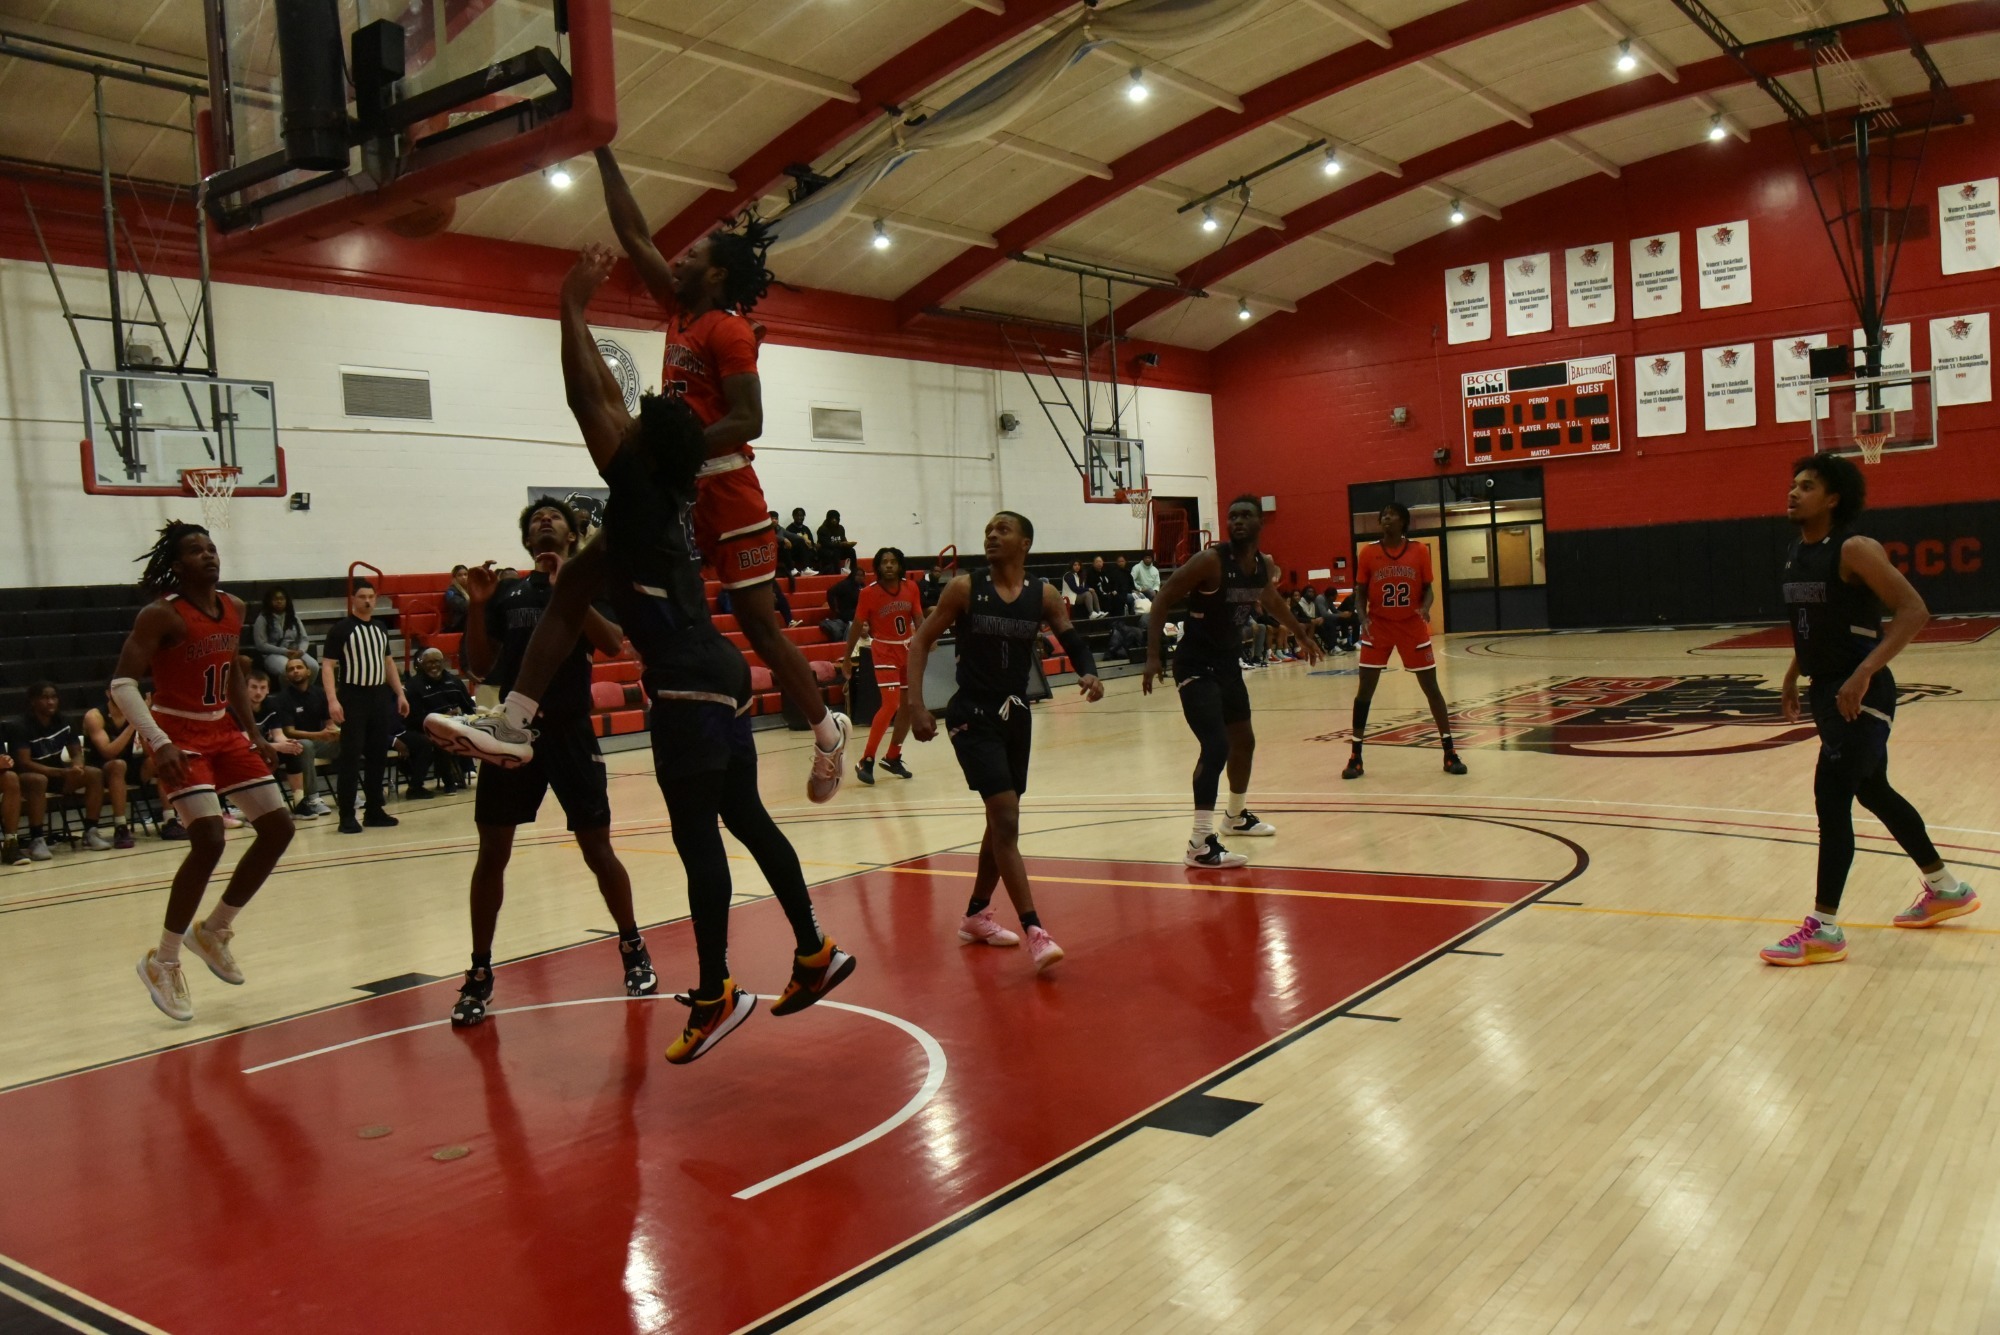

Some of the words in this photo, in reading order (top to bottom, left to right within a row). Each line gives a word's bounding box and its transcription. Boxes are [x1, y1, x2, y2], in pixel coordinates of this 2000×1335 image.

[1968, 201, 1991, 210] Basketball
[1959, 354, 1983, 362] Basketball
[619, 355, 634, 381] COLLEGE
[1957, 360, 1989, 369] Championship
[1570, 360, 1612, 381] BALTIMORE
[1467, 373, 1503, 386] BCCC
[1729, 379, 1749, 387] Basketball
[1576, 383, 1605, 395] GUEST
[1467, 395, 1511, 408] PANTHERS
[1528, 397, 1550, 405] PERIOD
[1566, 420, 1584, 429] T.O.L.
[1590, 417, 1610, 426] FOULS
[1519, 424, 1542, 433] PLAYER
[1546, 422, 1563, 430] FOUL
[1473, 430, 1491, 438] FOULS
[1591, 443, 1611, 451] SCORE
[1530, 449, 1550, 457] MATCH
[1474, 454, 1493, 463] SCORE
[1882, 536, 1984, 577] CCC
[1381, 582, 1411, 608] 22
[894, 615, 907, 636] 0
[1798, 607, 1810, 640] 4
[1001, 639, 1009, 670] 1
